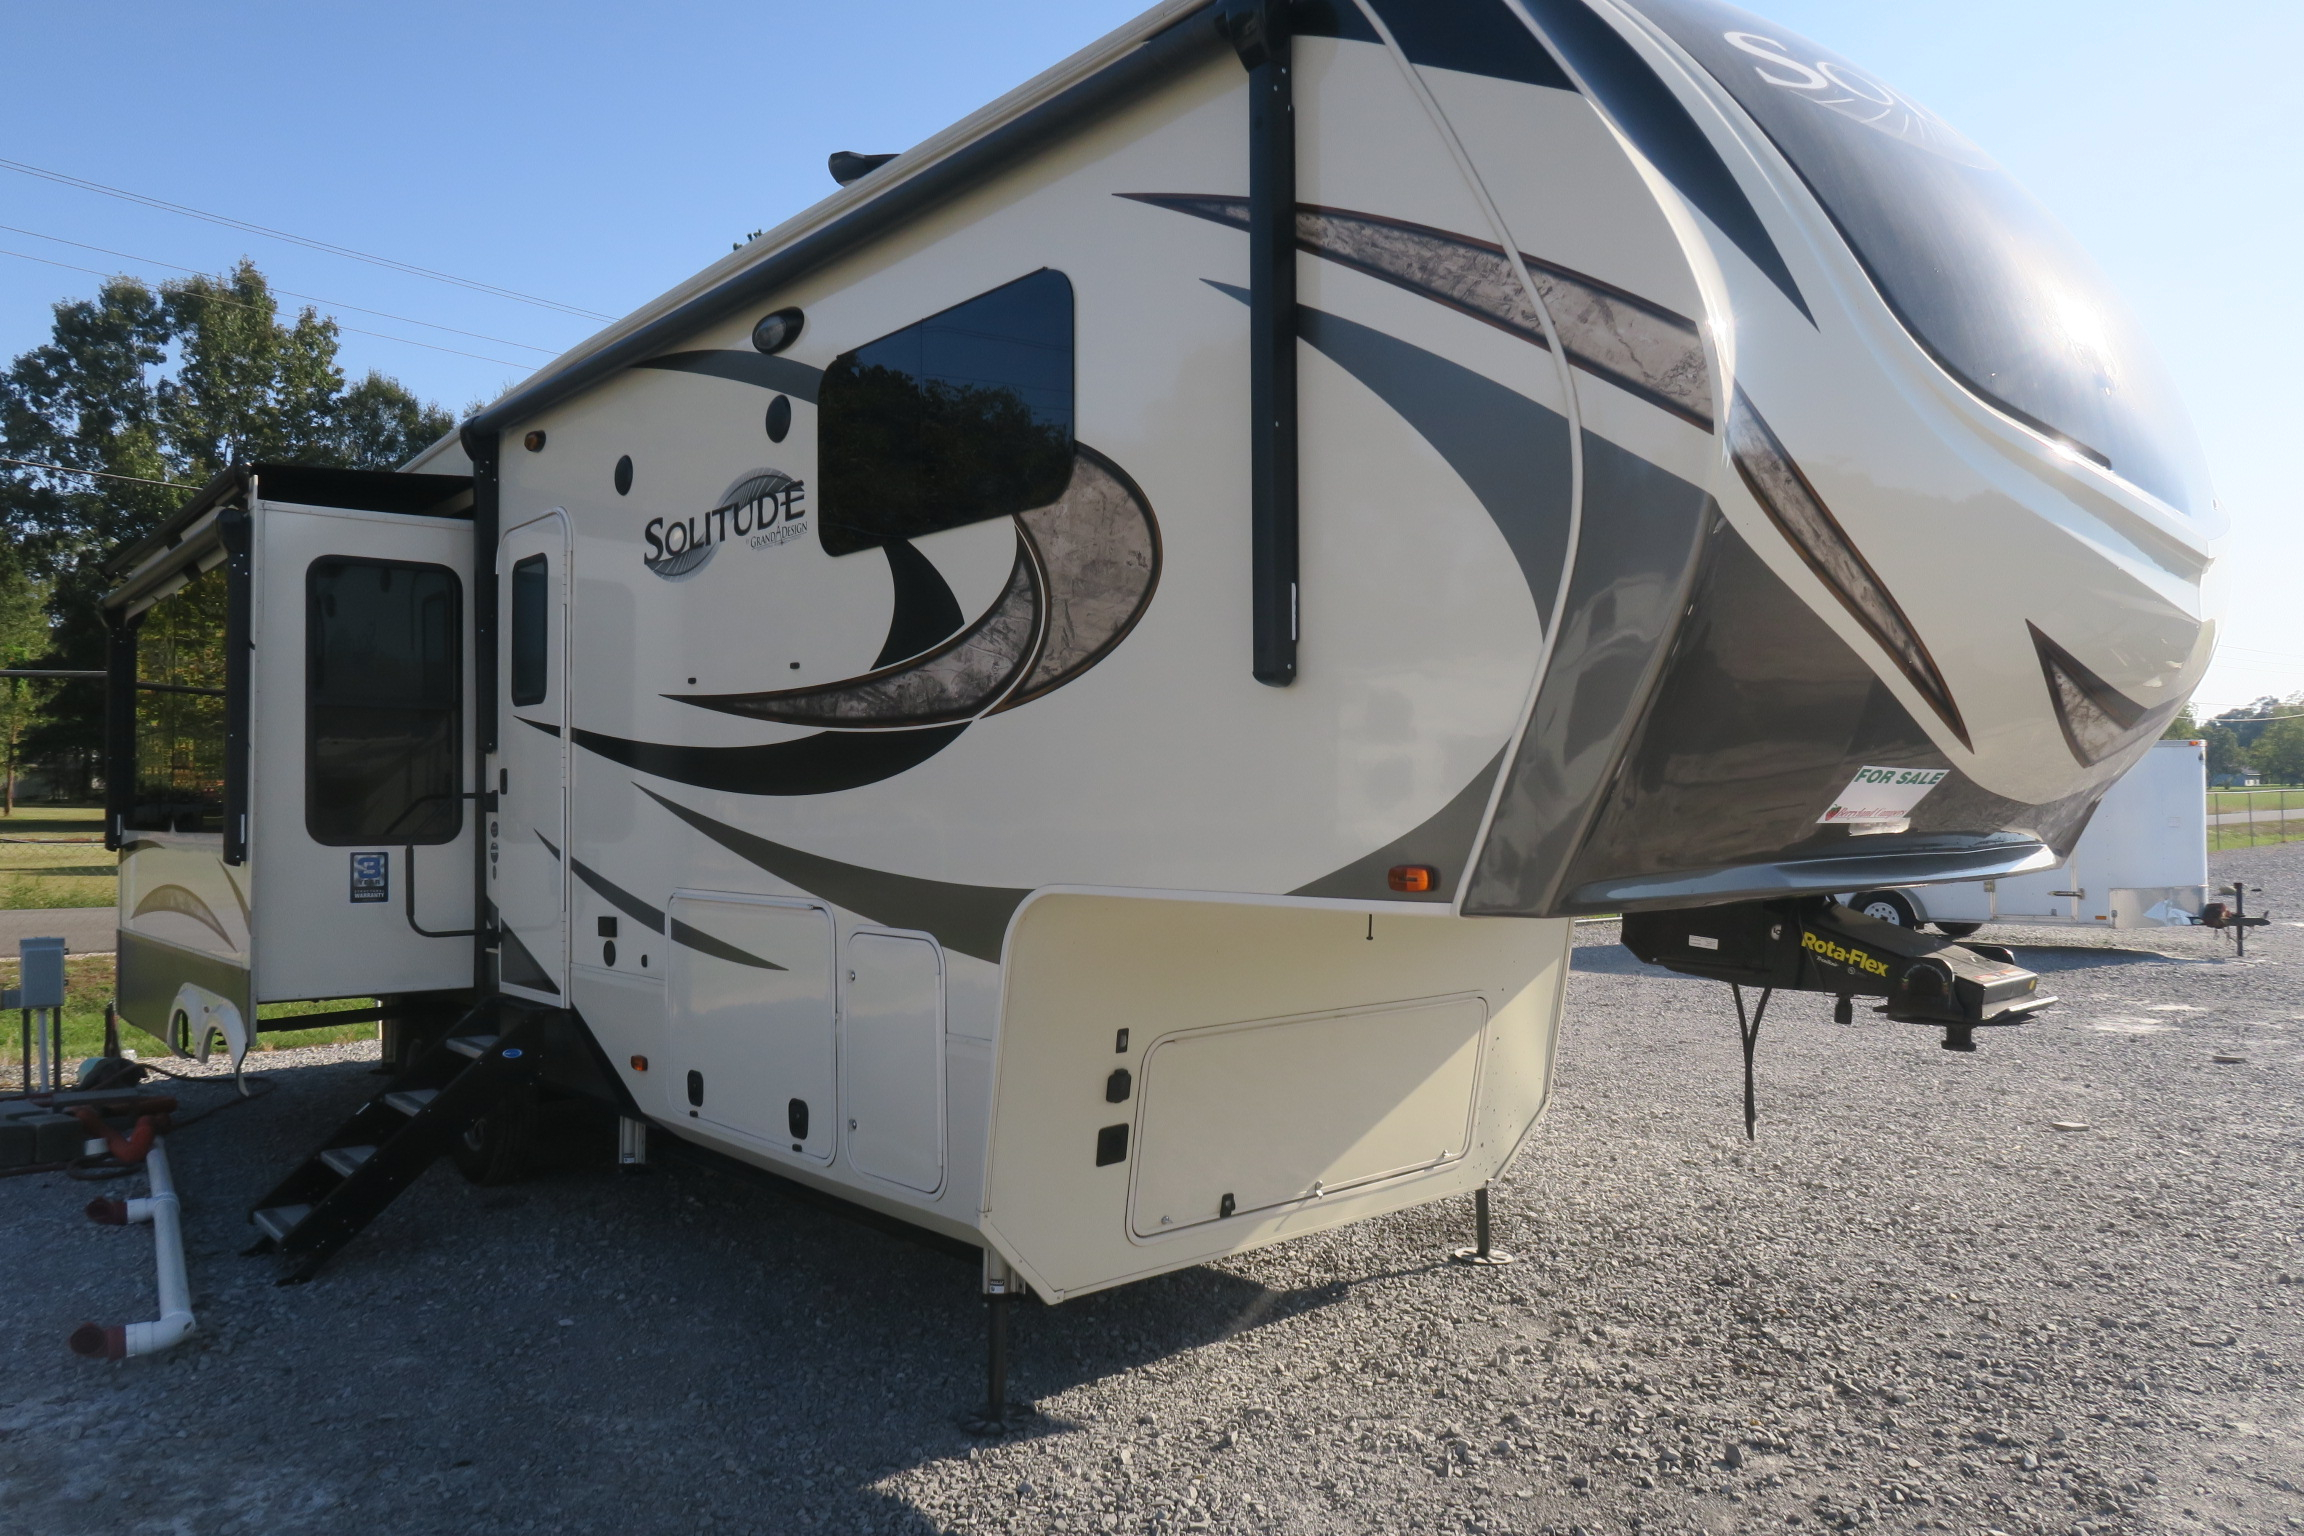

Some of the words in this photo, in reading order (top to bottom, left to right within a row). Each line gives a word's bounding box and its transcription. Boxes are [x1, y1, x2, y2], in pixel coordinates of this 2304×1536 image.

[644, 480, 806, 565] SOLITUDE
[750, 532, 776, 549] GRAND
[782, 521, 807, 538] DESIGN
[1854, 769, 1895, 783] FOR
[1896, 772, 1944, 784] SALE
[357, 857, 381, 879] 3
